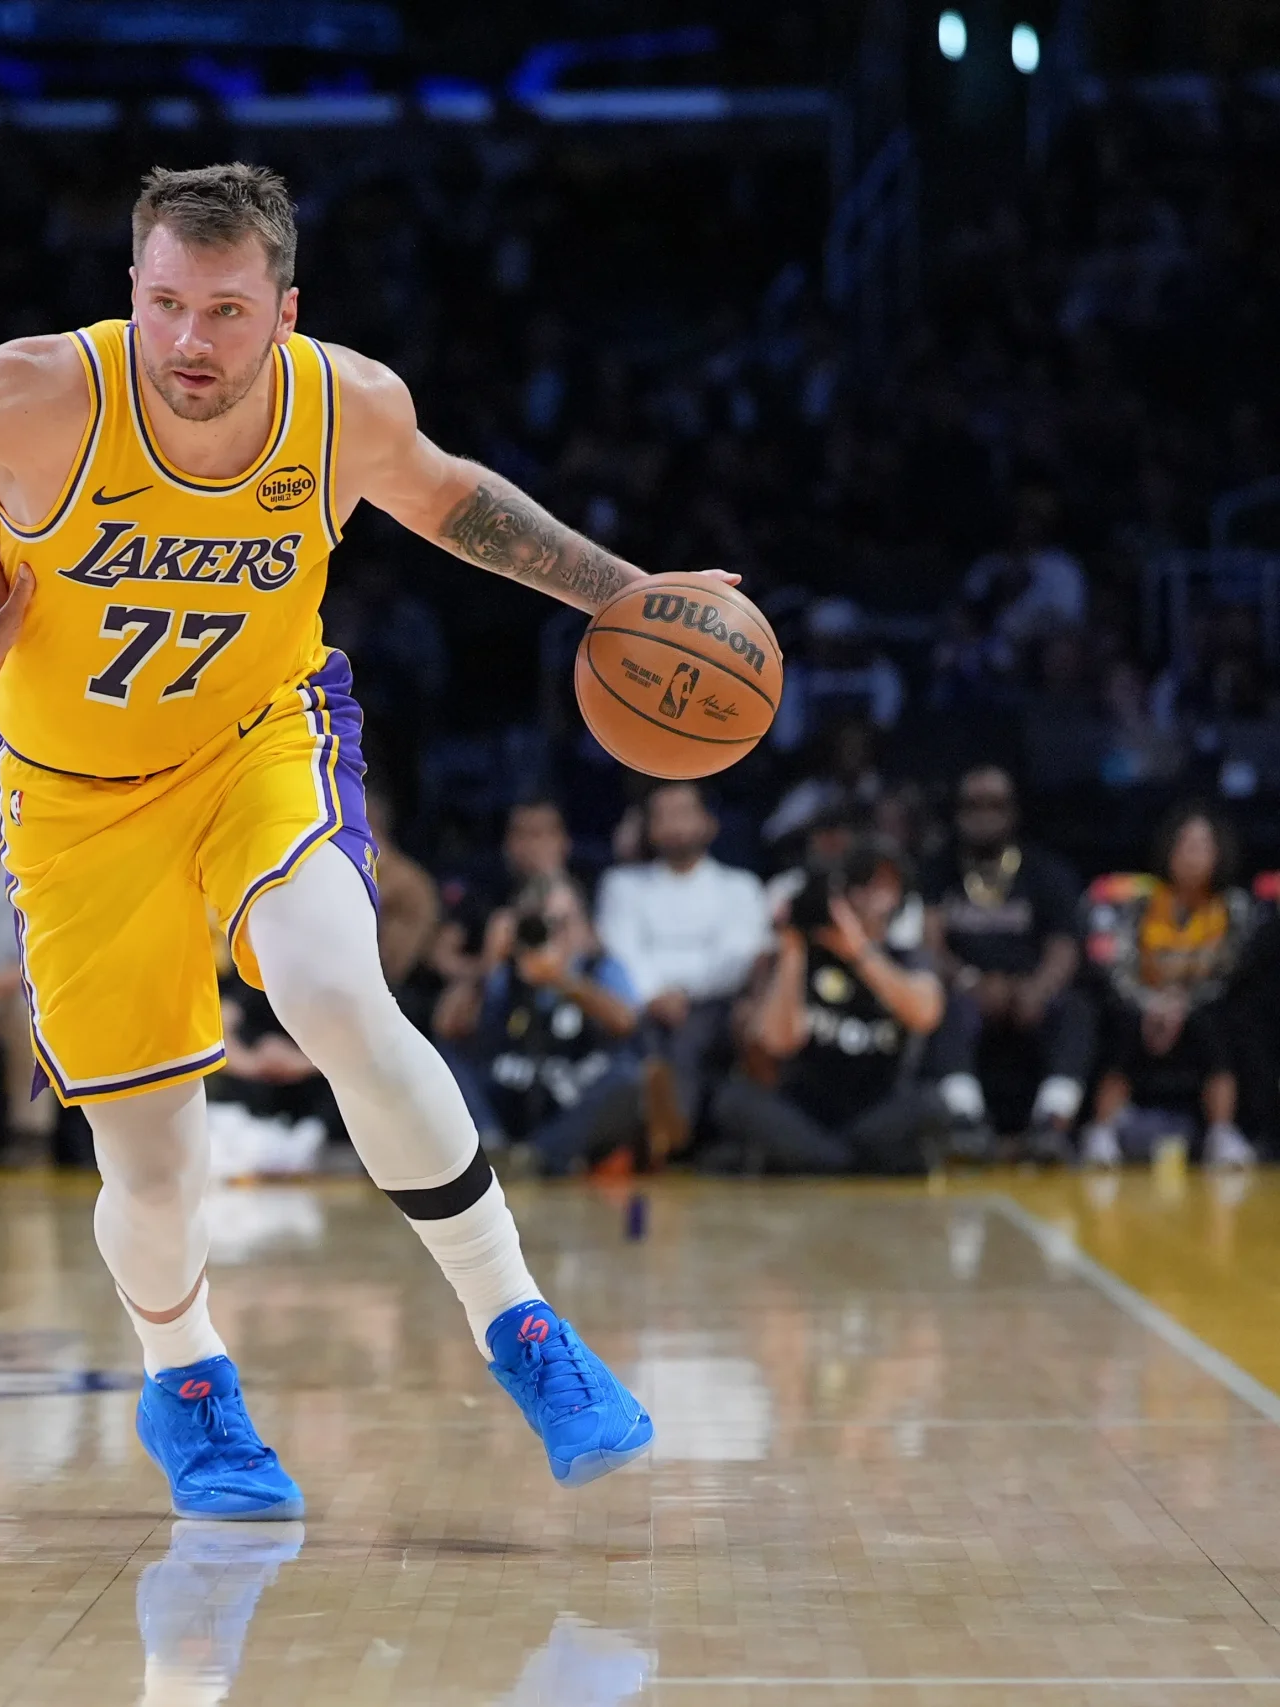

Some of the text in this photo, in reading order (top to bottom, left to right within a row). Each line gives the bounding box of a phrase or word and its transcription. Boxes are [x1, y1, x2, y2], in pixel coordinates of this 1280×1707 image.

[262, 478, 312, 497] bibigo
[270, 493, 292, 503] 비비고
[57, 520, 303, 592] LAKERS
[83, 604, 250, 709] 77
[642, 594, 765, 675] Wilson
